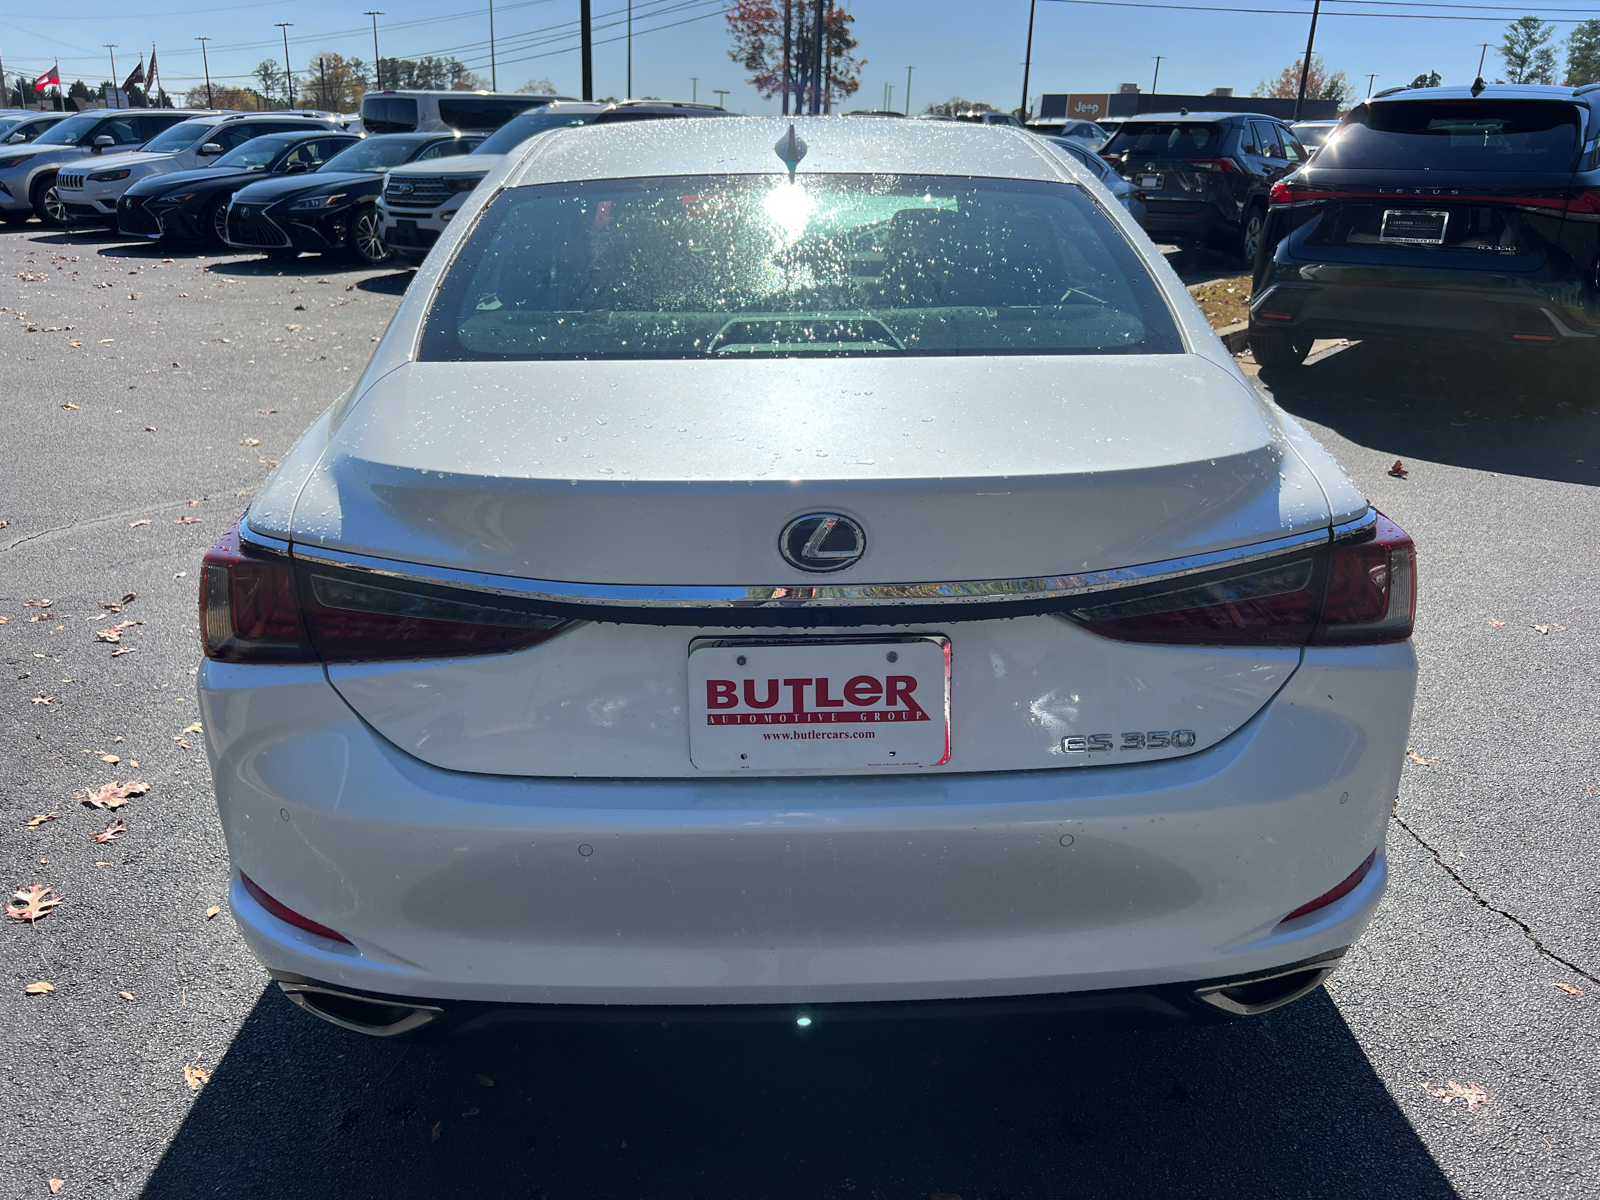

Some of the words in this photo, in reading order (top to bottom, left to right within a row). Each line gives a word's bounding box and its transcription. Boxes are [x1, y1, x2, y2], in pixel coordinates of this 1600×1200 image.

[1074, 101, 1100, 115] Jeep
[708, 713, 838, 724] AUTOMOTIVE
[860, 711, 923, 722] GROUP
[762, 729, 876, 741] www.butlercars.com
[1061, 733, 1114, 753] ES
[1120, 729, 1196, 750] 350
